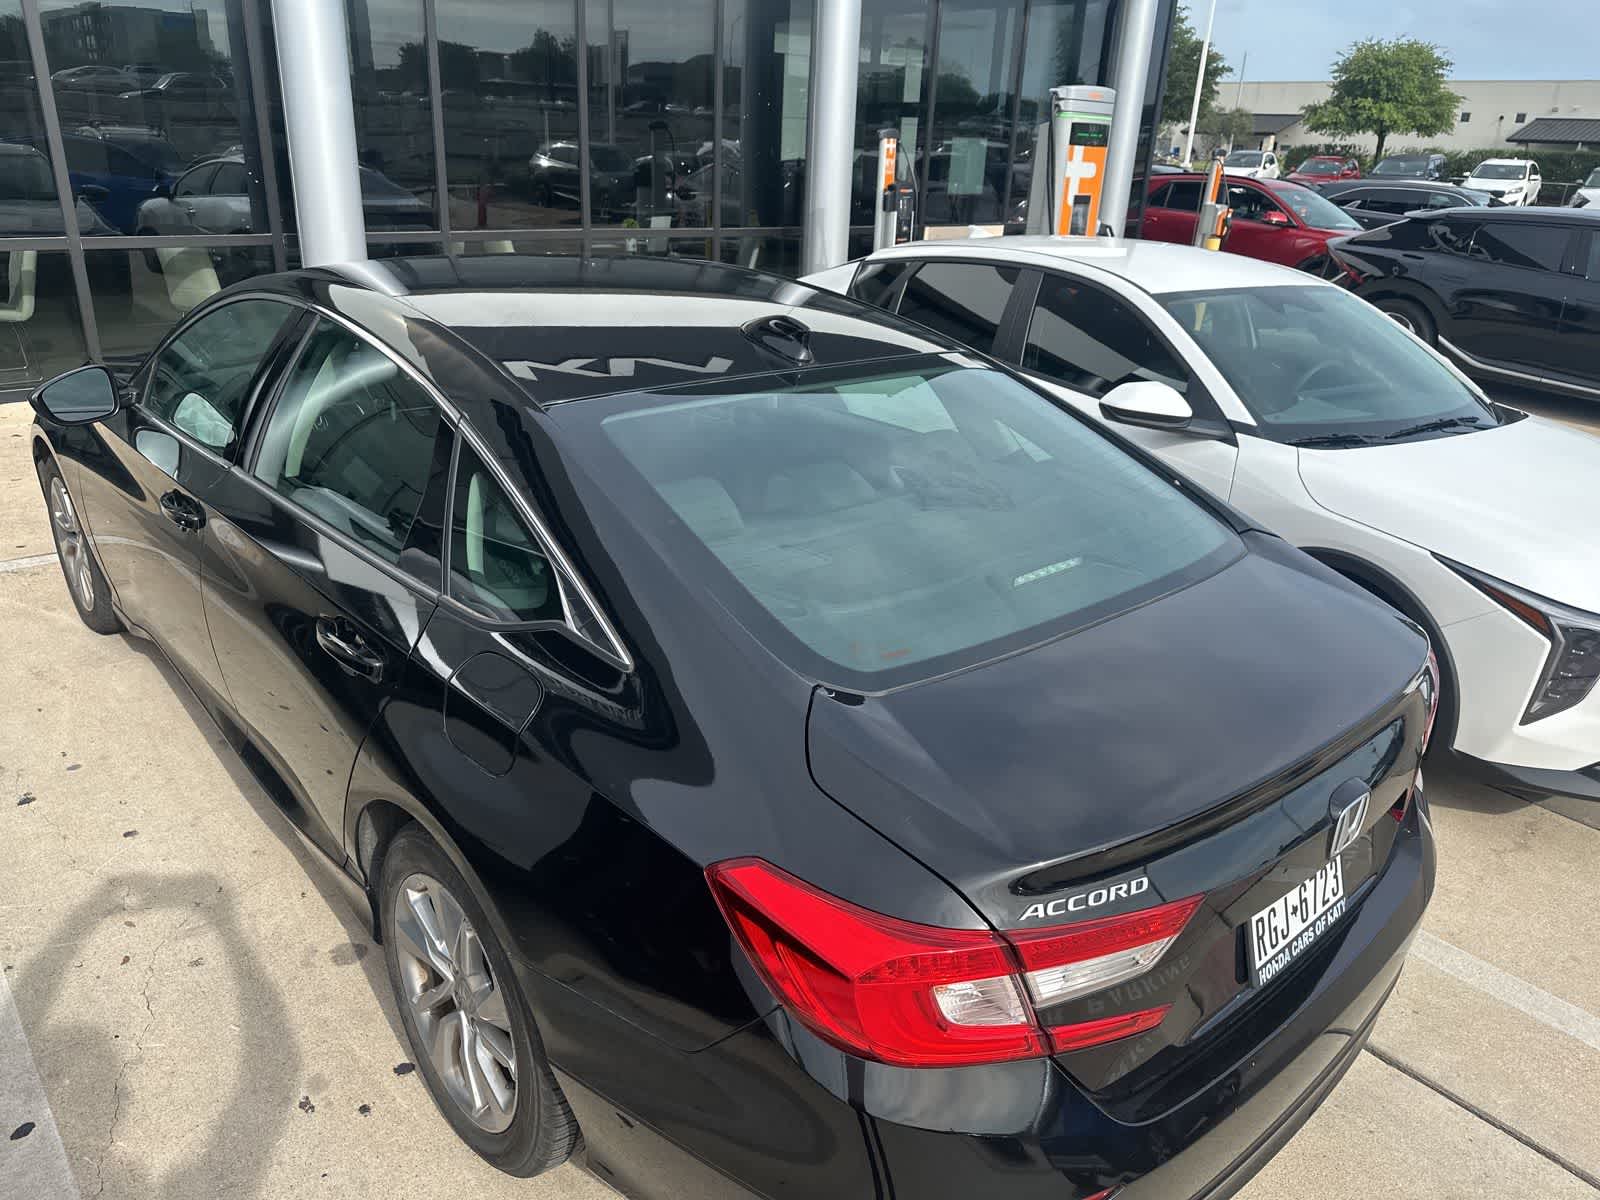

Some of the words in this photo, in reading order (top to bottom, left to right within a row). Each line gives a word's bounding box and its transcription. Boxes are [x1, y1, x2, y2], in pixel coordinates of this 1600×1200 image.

[1018, 876, 1150, 921] ACCORD
[1255, 896, 1290, 962] RGJ
[1299, 857, 1340, 923] 6723
[1258, 948, 1291, 986] HONDA
[1291, 928, 1315, 956] CARS
[1315, 918, 1326, 936] OF
[1326, 896, 1347, 926] KATY
